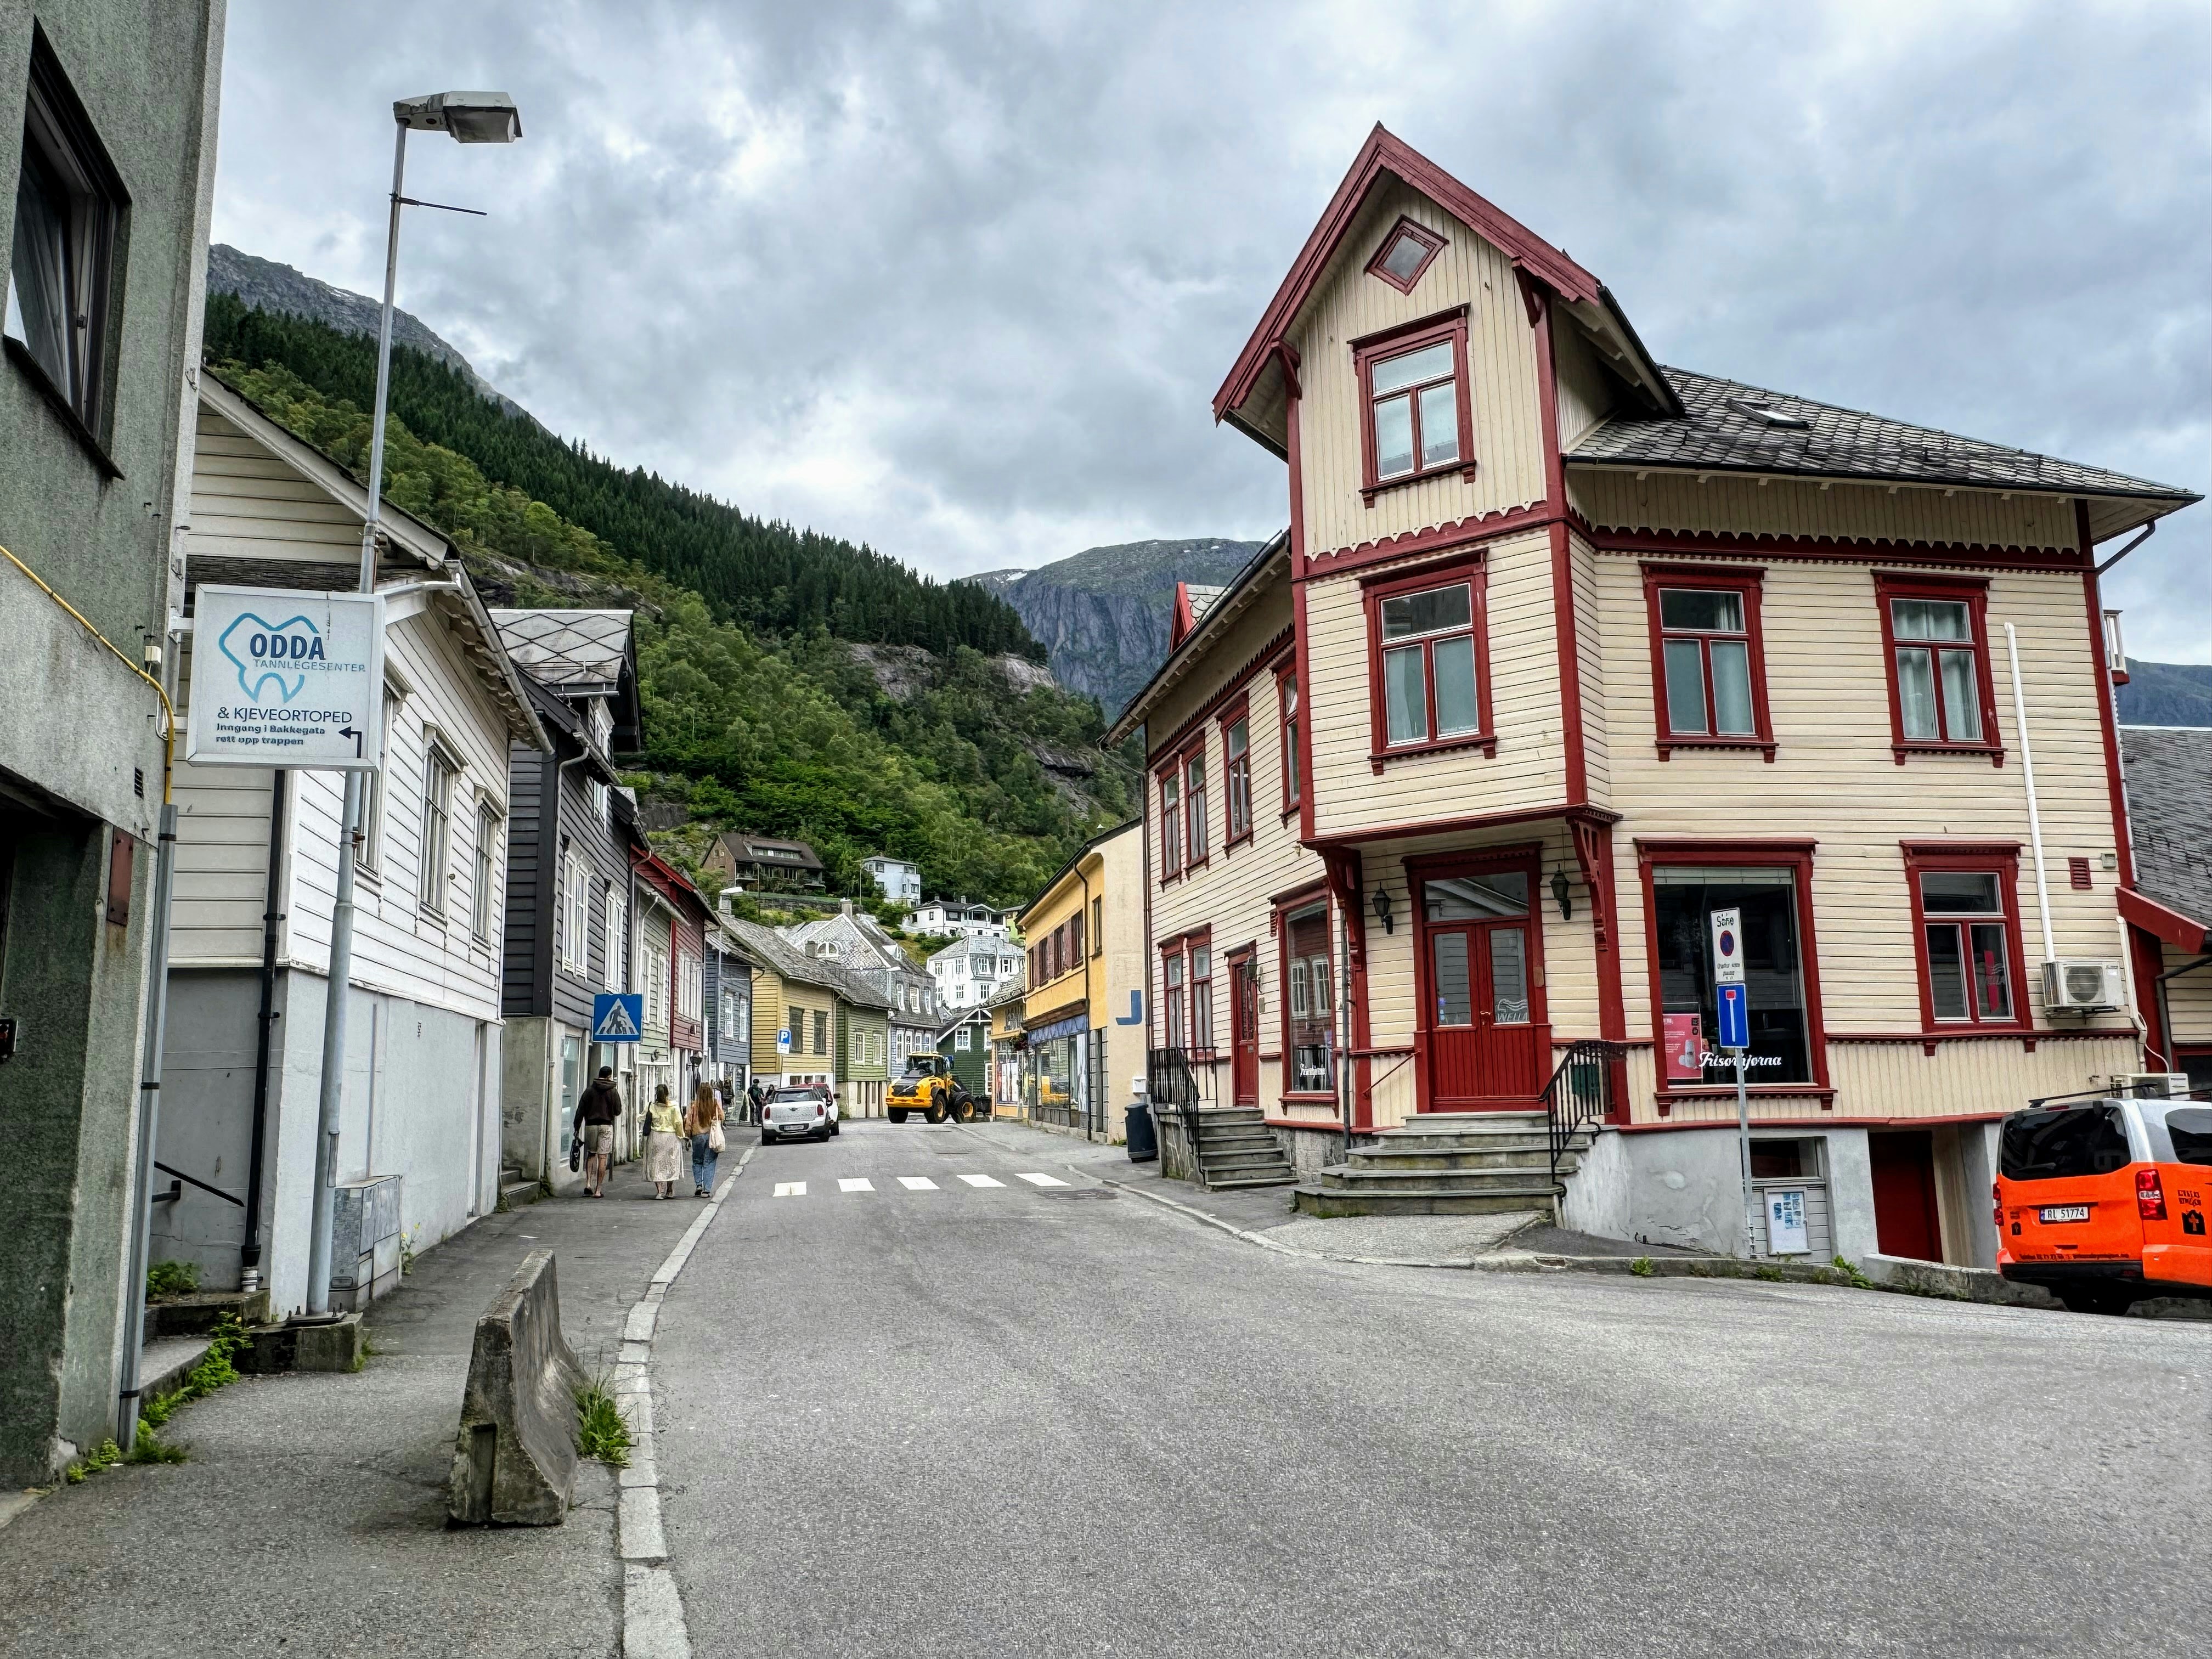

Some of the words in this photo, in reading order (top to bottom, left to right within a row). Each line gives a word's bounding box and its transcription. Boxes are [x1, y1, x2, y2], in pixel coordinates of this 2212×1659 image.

[250, 634, 326, 660] ODDA
[253, 658, 366, 672] TANNLEGESENTER
[217, 707, 230, 719] &
[234, 707, 352, 723] KJEVEORTOPED
[217, 723, 261, 733] Inngang
[264, 724, 267, 732] i
[262, 737, 304, 746] trappen
[781, 1031, 788, 1042] P
[2061, 1208, 2084, 1218] 51774
